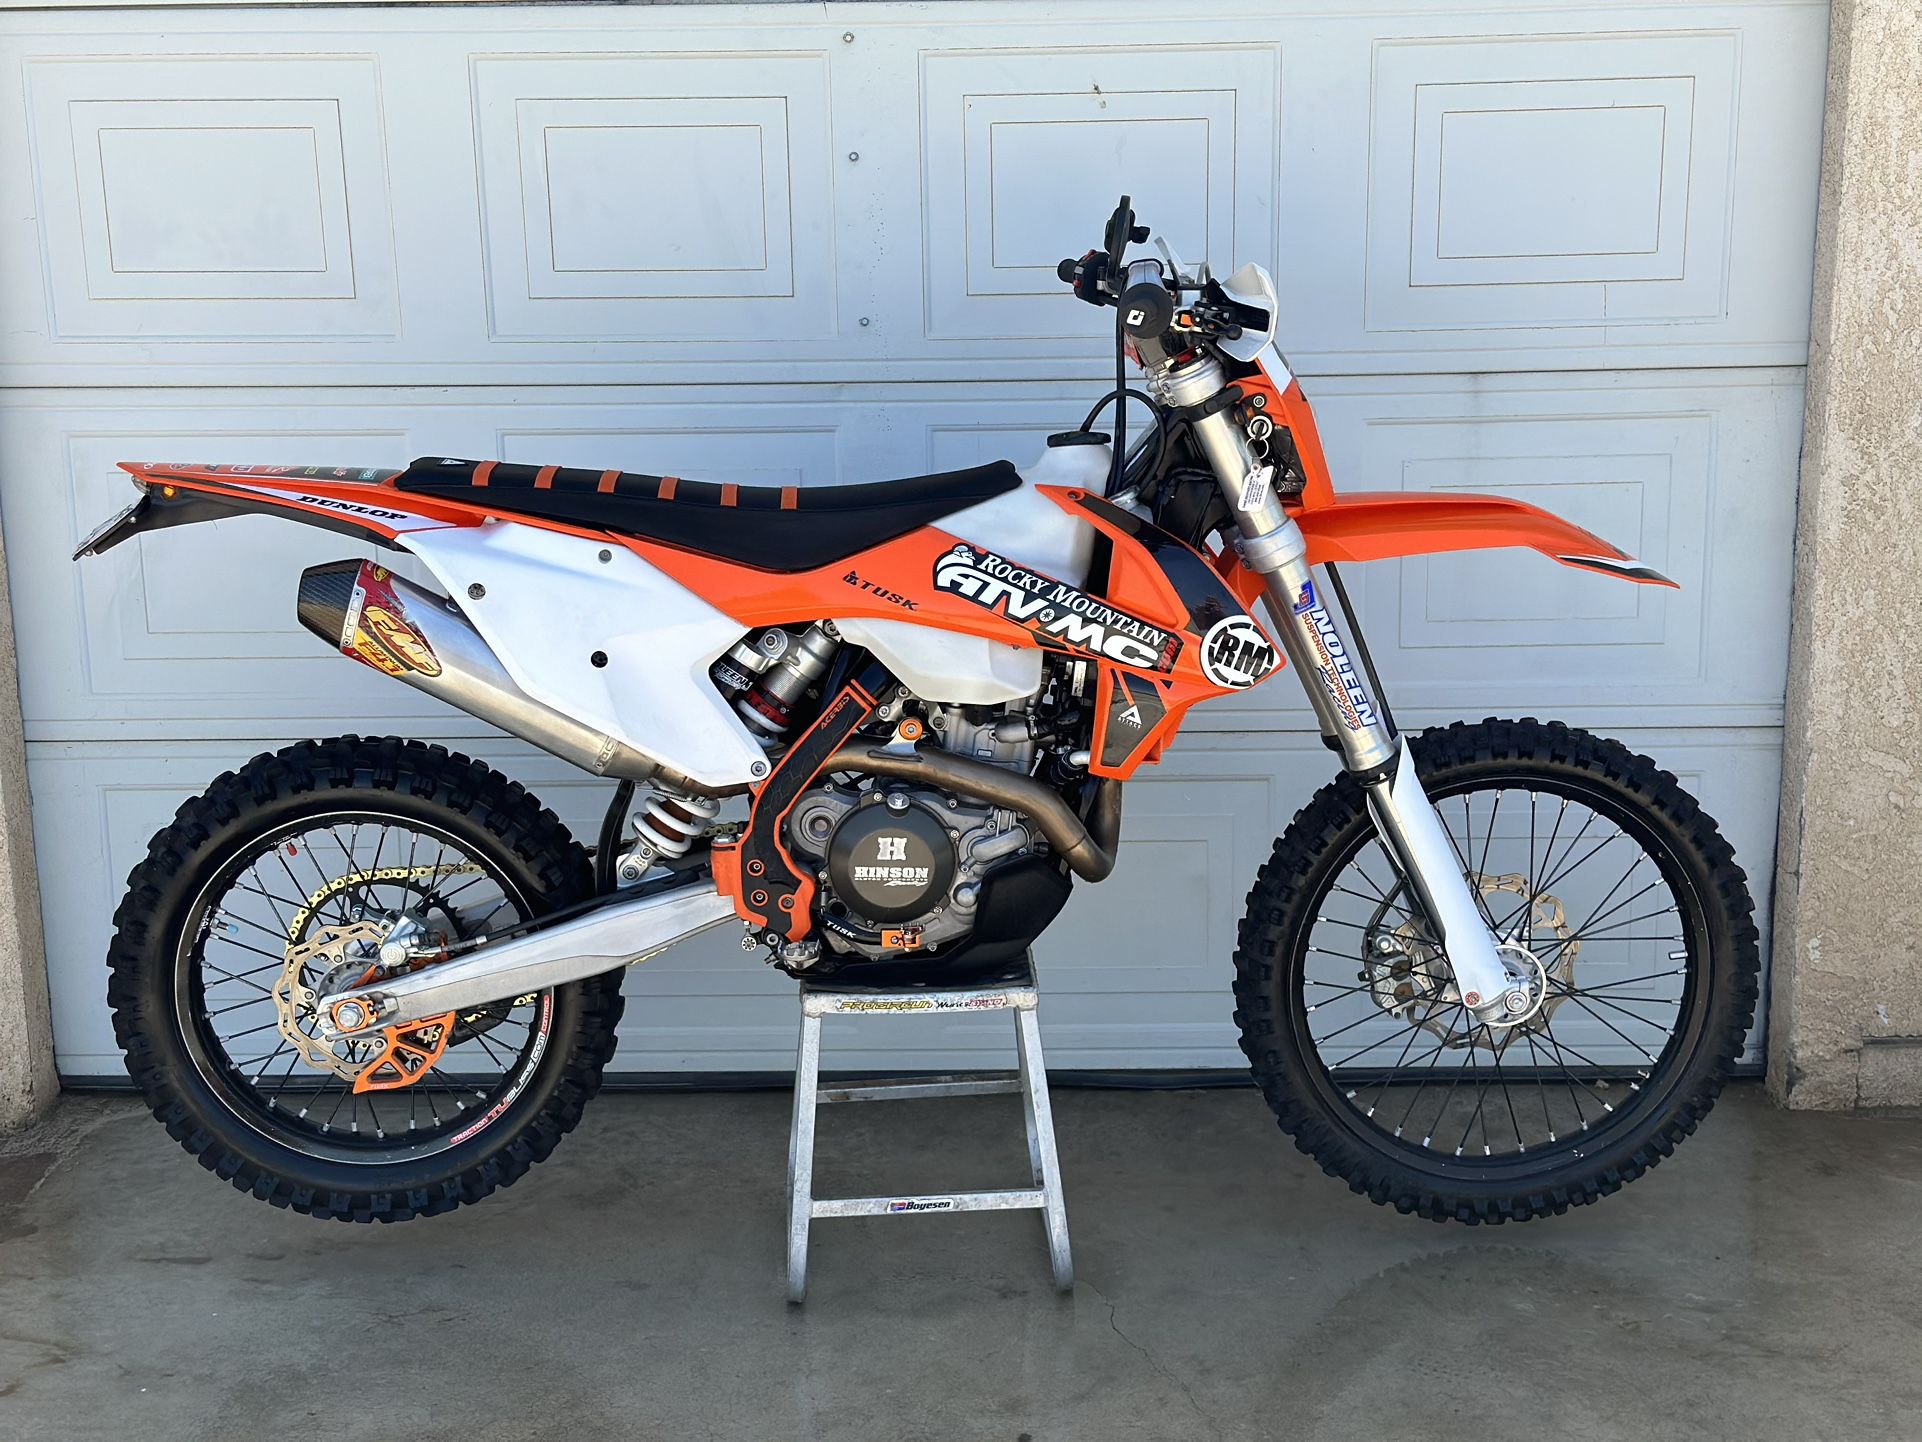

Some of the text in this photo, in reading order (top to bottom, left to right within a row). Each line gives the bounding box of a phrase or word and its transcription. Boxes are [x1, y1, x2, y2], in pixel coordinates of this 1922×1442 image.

[296, 495, 408, 520] DUNLOP
[860, 580, 919, 611] TUSK
[977, 554, 1168, 646] ROCKY MOUNTAIN
[363, 607, 441, 673] FMF
[1215, 632, 1269, 678] RM
[1302, 612, 1361, 730] SUSPENSION TECHNOLOGIES
[1309, 606, 1377, 727] NOLEEN
[877, 837, 907, 861] H
[854, 866, 929, 879] HINSON
[826, 919, 857, 939] TUSK
[906, 1200, 951, 1211] Boyesen
